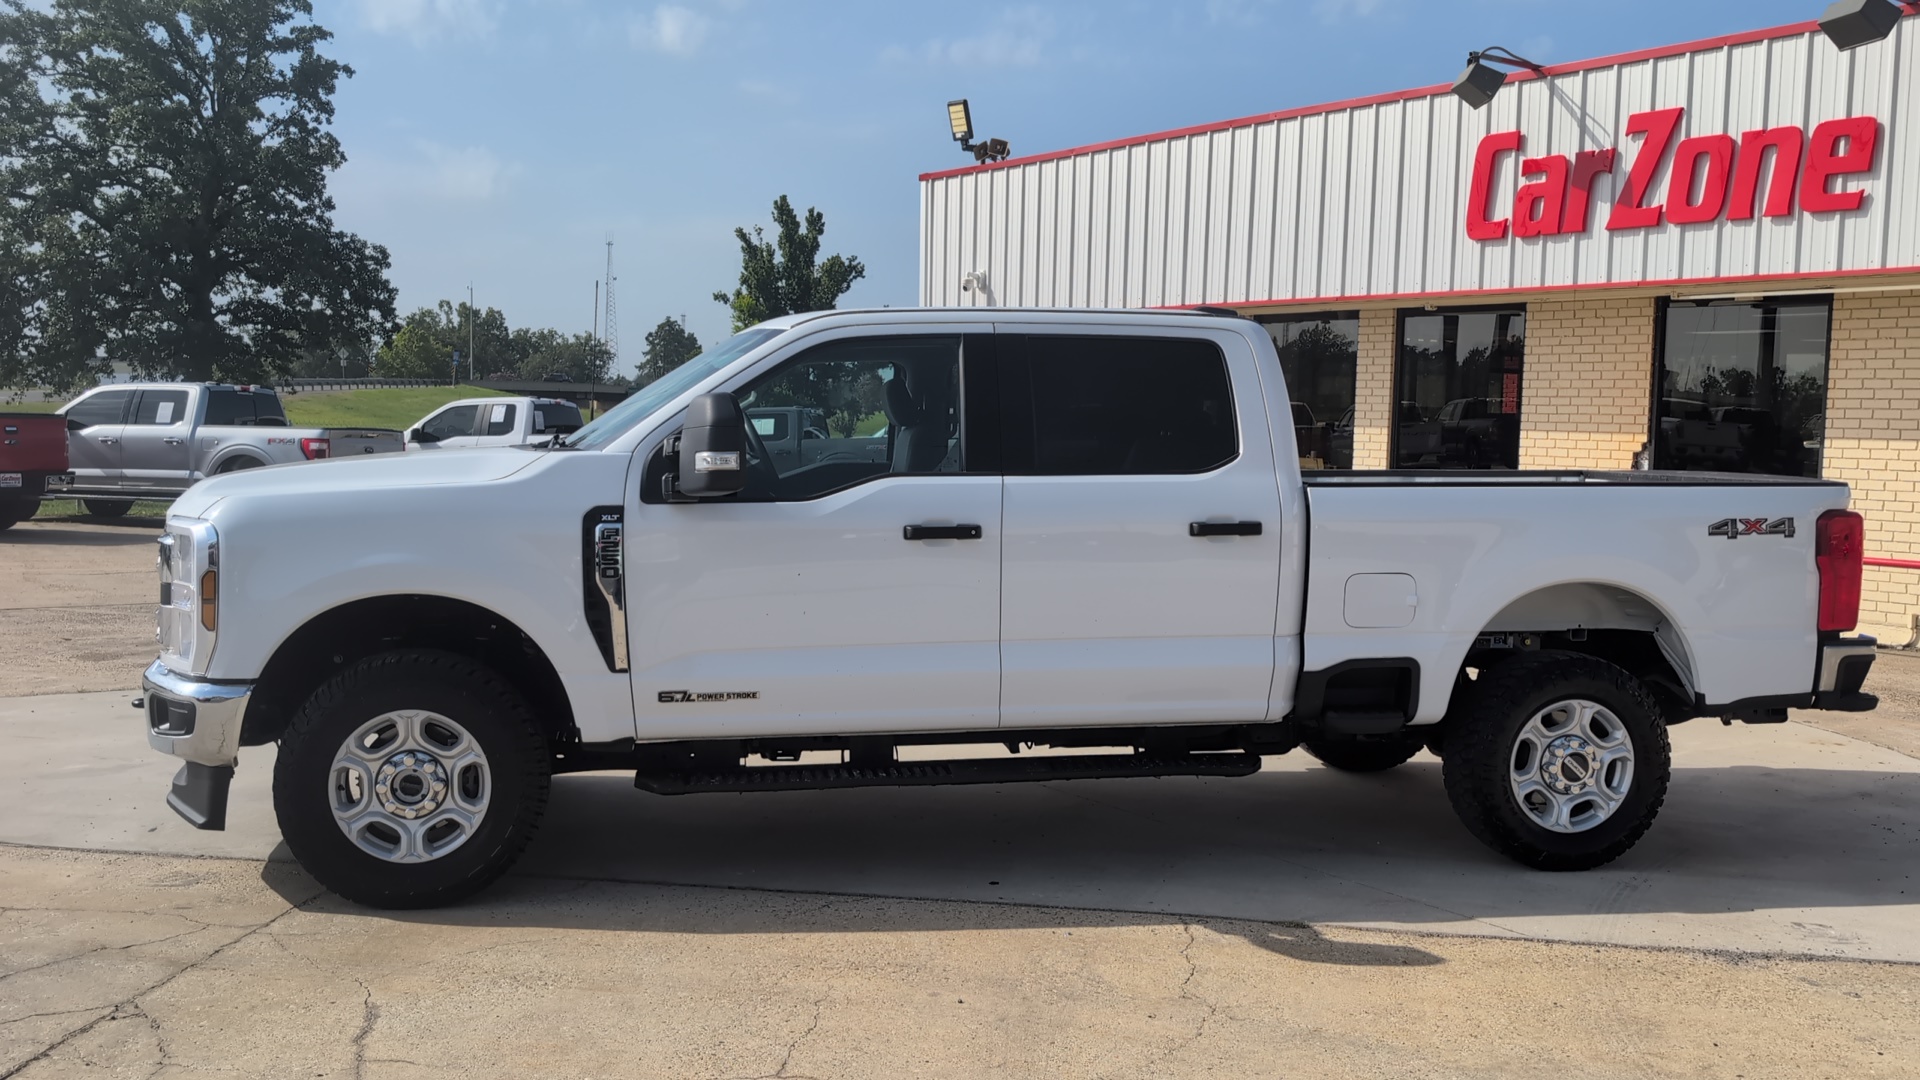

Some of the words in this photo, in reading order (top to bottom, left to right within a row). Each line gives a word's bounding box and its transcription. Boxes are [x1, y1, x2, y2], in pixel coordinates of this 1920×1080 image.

[1466, 107, 1878, 241] CarZone
[696, 693, 725, 701] POWER
[726, 692, 758, 700] STROKE
